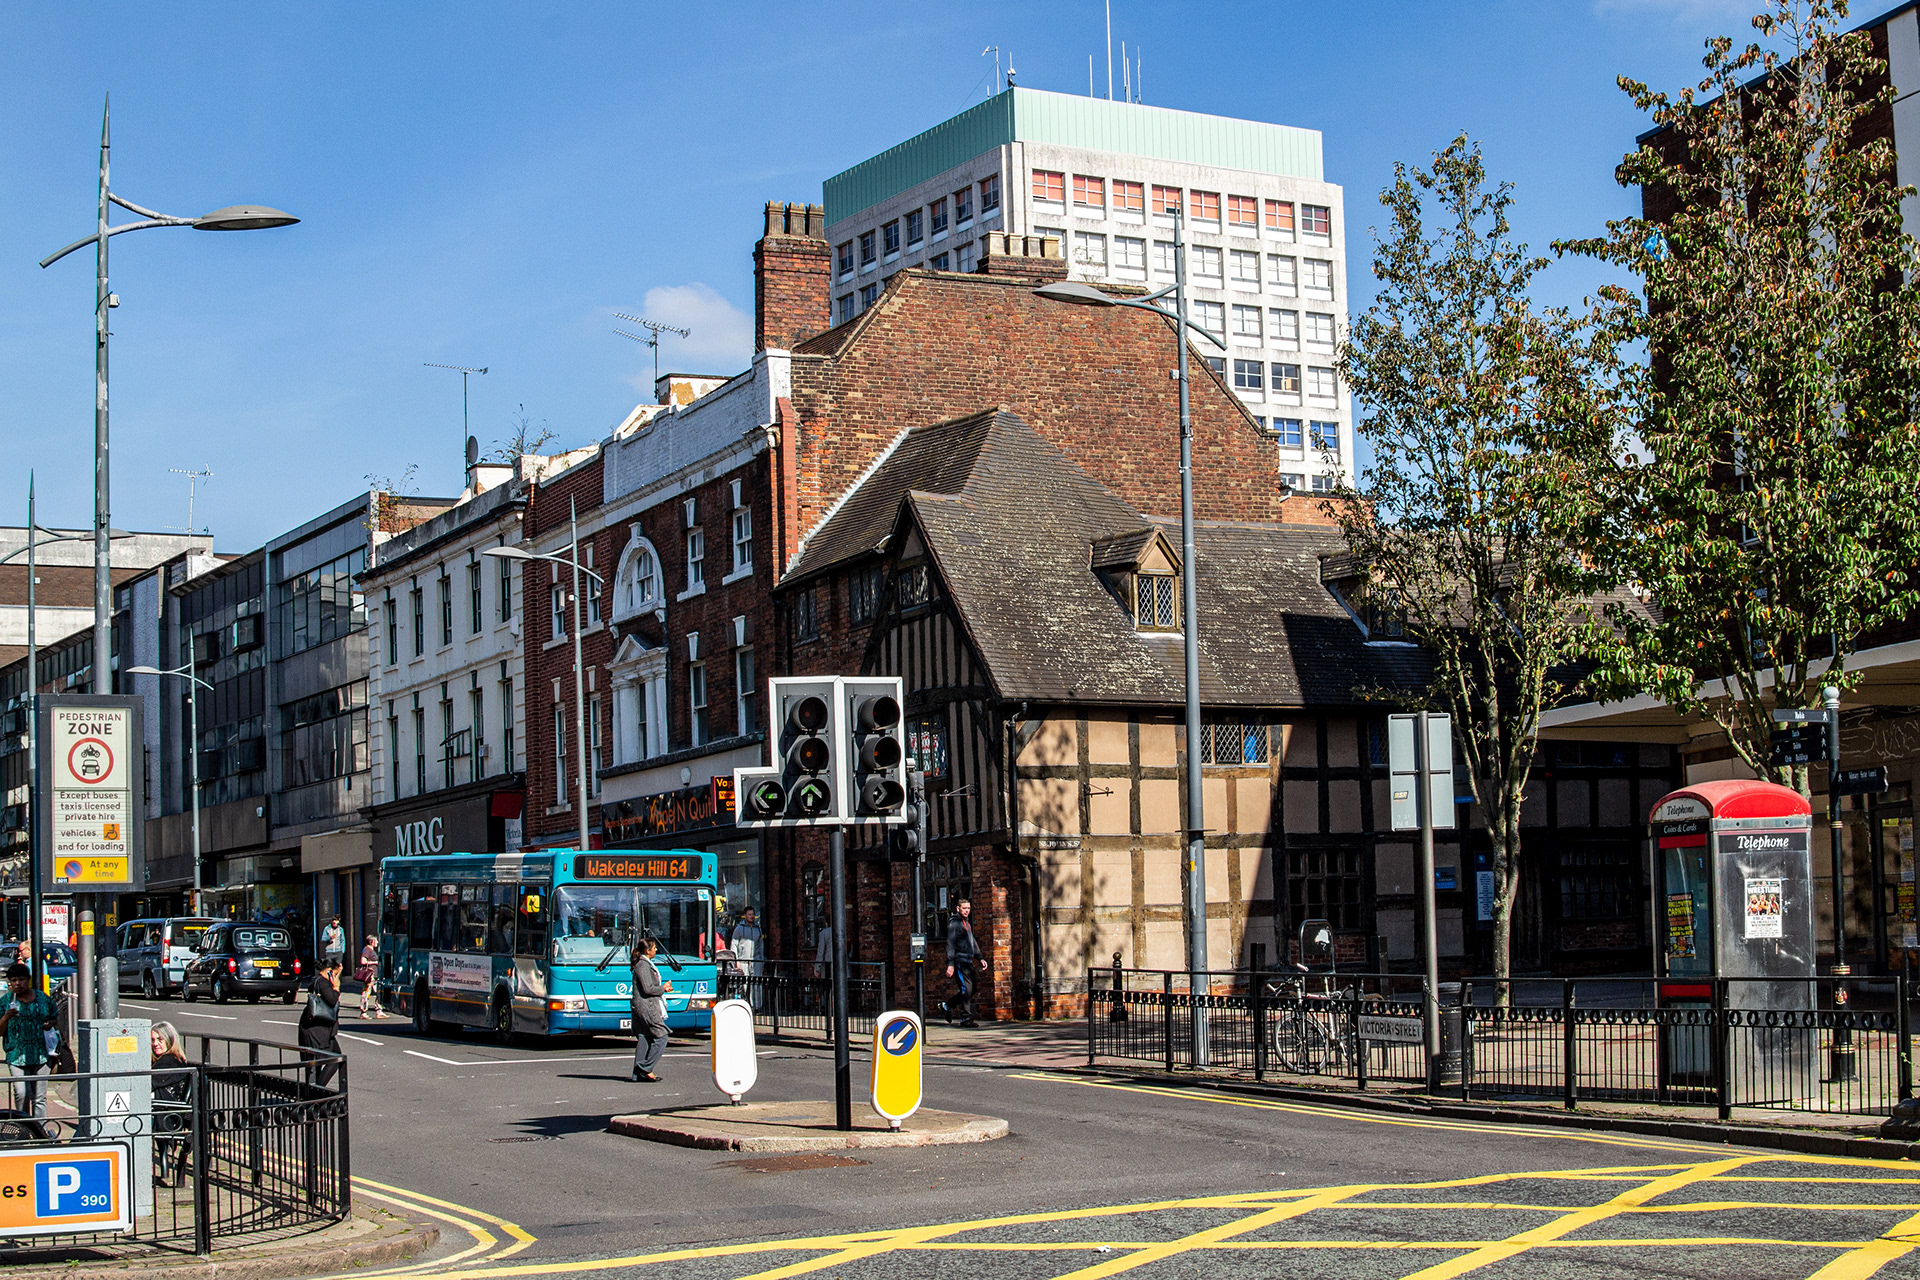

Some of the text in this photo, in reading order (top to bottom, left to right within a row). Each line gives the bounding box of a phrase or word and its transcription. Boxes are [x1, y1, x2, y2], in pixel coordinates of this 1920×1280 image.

[59, 712, 122, 721] PEDESTRIAN
[68, 723, 113, 735] ZONE
[60, 791, 91, 800] Except
[85, 802, 121, 810] licensed
[677, 800, 686, 822] N
[689, 794, 712, 821] Quit
[1667, 805, 1695, 816] Telephone
[65, 813, 96, 821] private
[1682, 823, 1697, 832] Cards
[394, 817, 444, 857] MRG
[1737, 835, 1789, 850] Telephone
[92, 842, 124, 851] loading
[588, 860, 687, 877] Wakeley Hill 64
[1747, 886, 1780, 894] WRESTLING
[1360, 1021, 1421, 1037] VICTORIA STREET
[2, 1185, 27, 1198] es
[48, 1166, 81, 1210] P
[81, 1194, 107, 1206] 390
